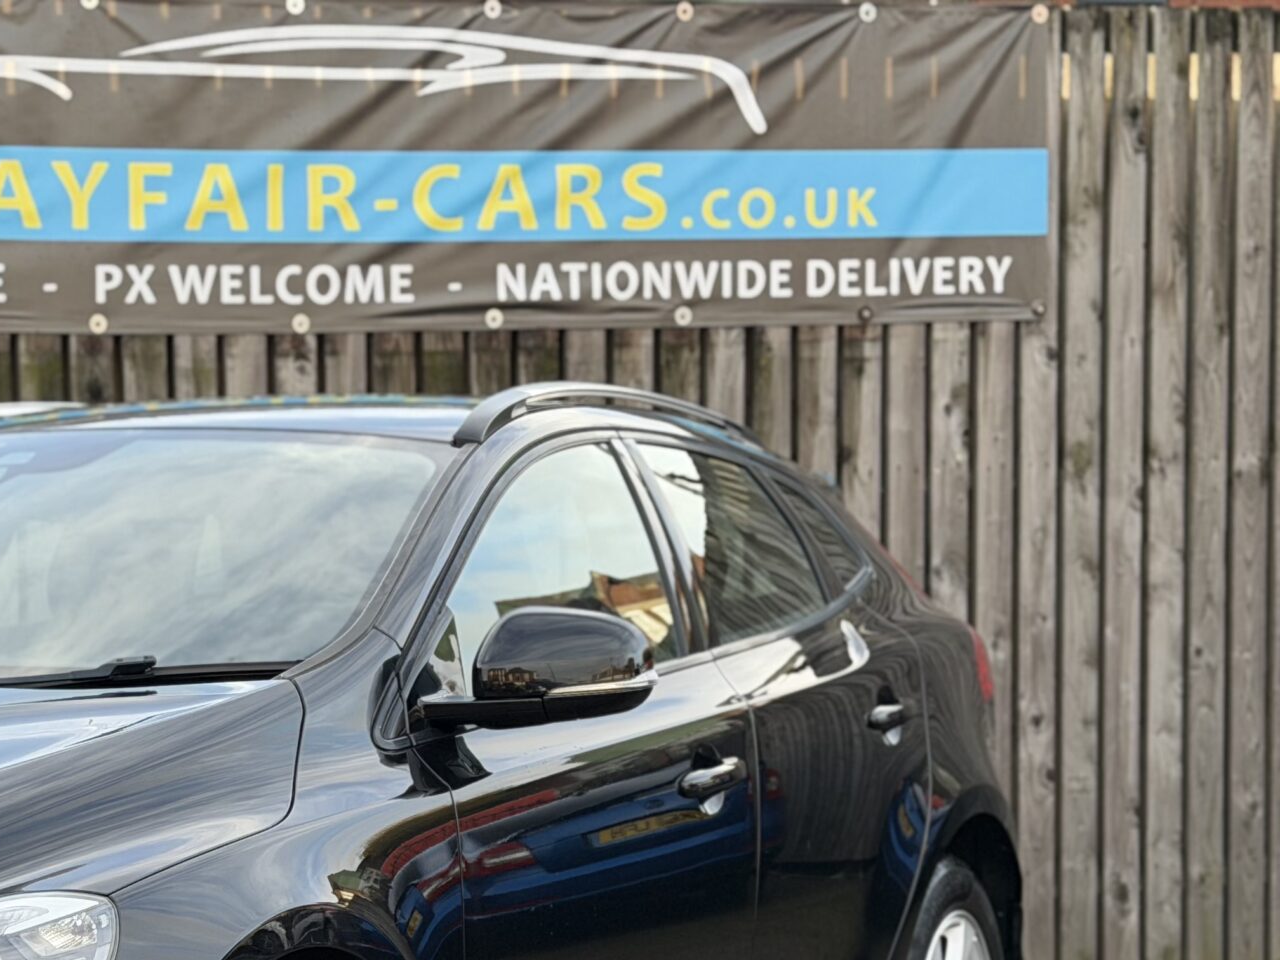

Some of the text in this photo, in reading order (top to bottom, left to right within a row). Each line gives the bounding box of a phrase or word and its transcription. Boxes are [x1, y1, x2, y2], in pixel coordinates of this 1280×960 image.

[95, 264, 156, 303] PX
[168, 264, 415, 305] WELCOME
[495, 259, 792, 302] NATIONWIDE
[806, 255, 1013, 297] DELIVERY
